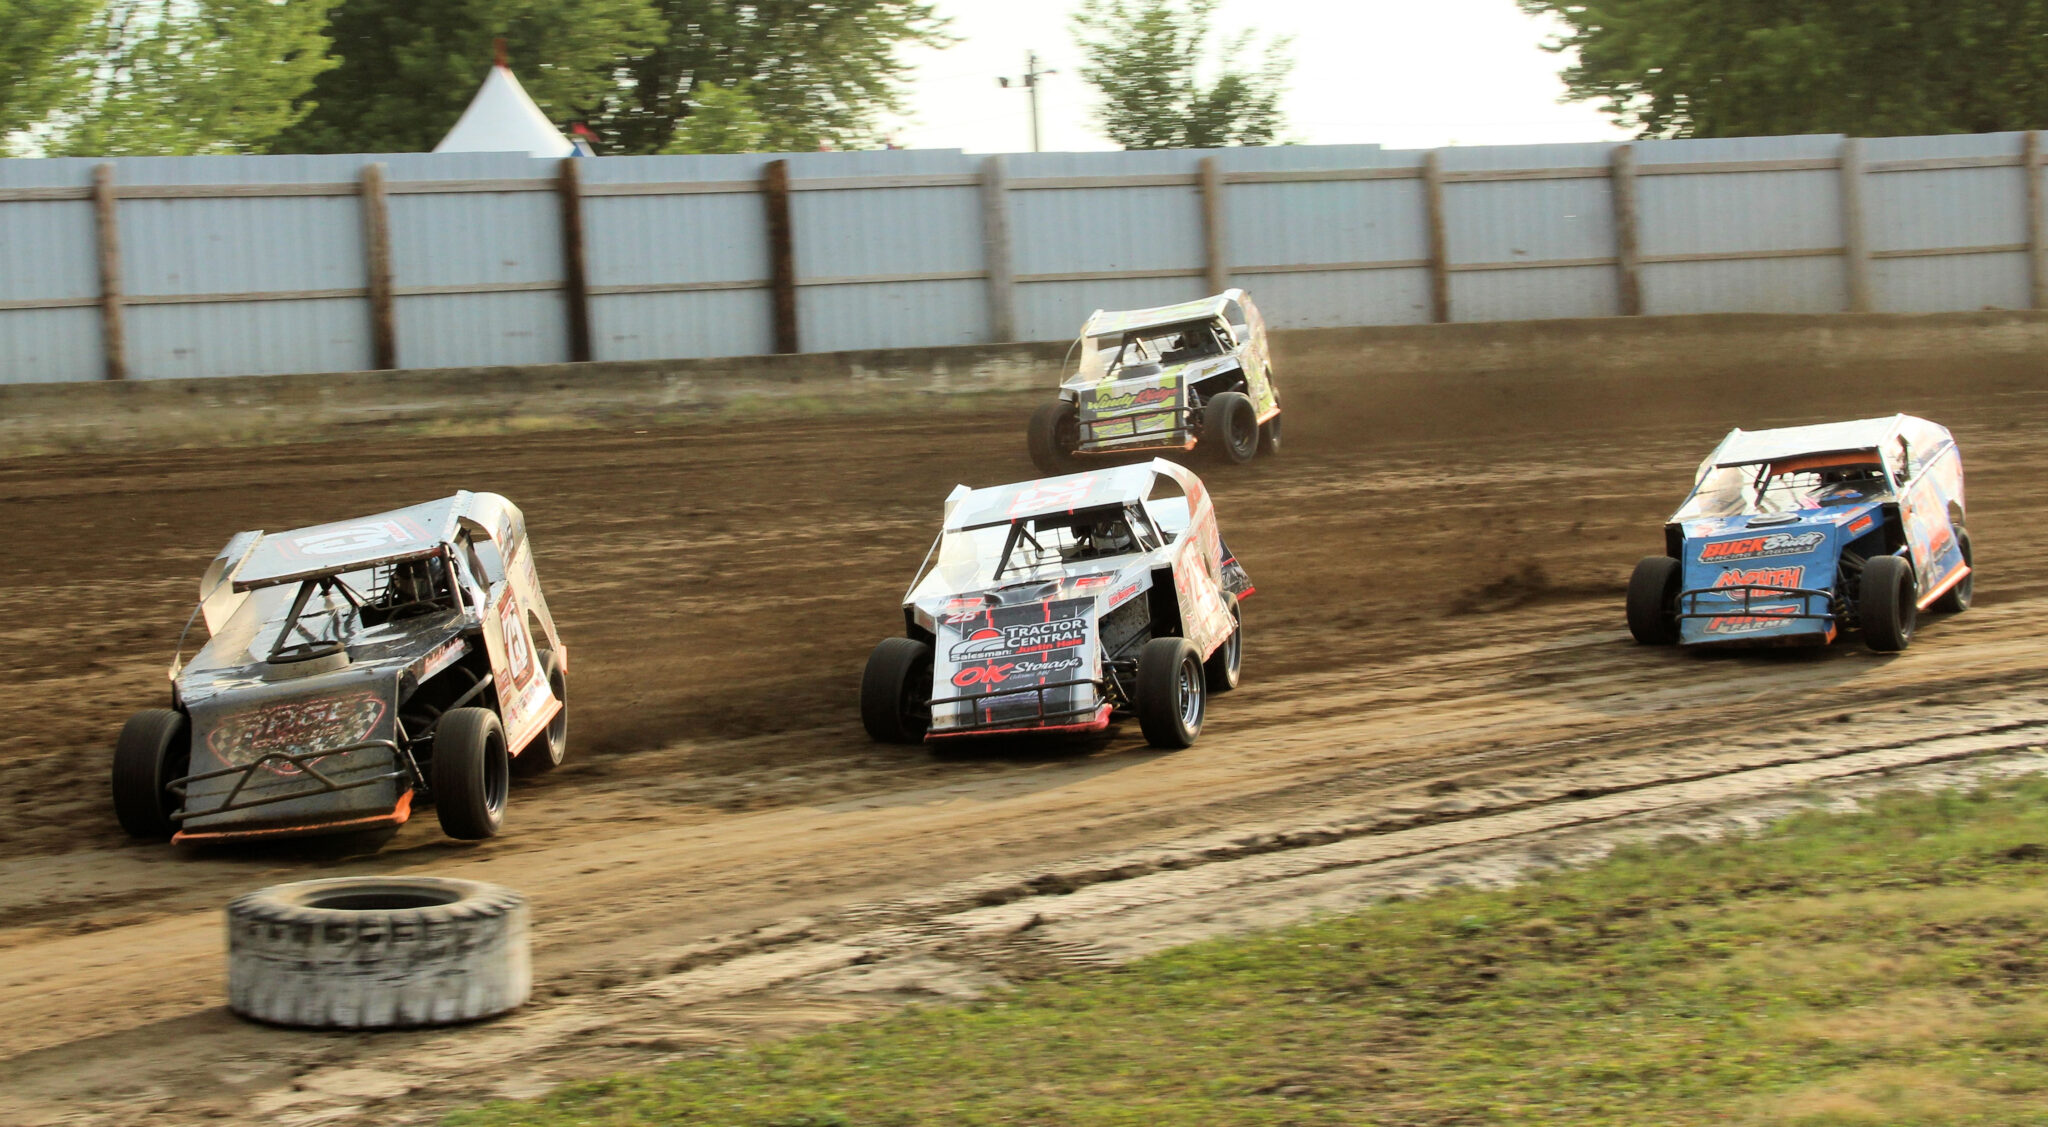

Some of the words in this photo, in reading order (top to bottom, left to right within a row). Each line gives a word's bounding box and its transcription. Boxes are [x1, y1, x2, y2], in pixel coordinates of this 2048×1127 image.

[1701, 537, 1769, 559] BUCK
[1705, 552, 1753, 562] RACING
[1716, 567, 1801, 590] MOUTH
[1007, 619, 1083, 638] TRACTOR
[1006, 630, 1082, 648] CENTRAL
[951, 649, 1012, 662] Salesman:
[1015, 643, 1053, 655] Justin
[952, 662, 1015, 687] OK
